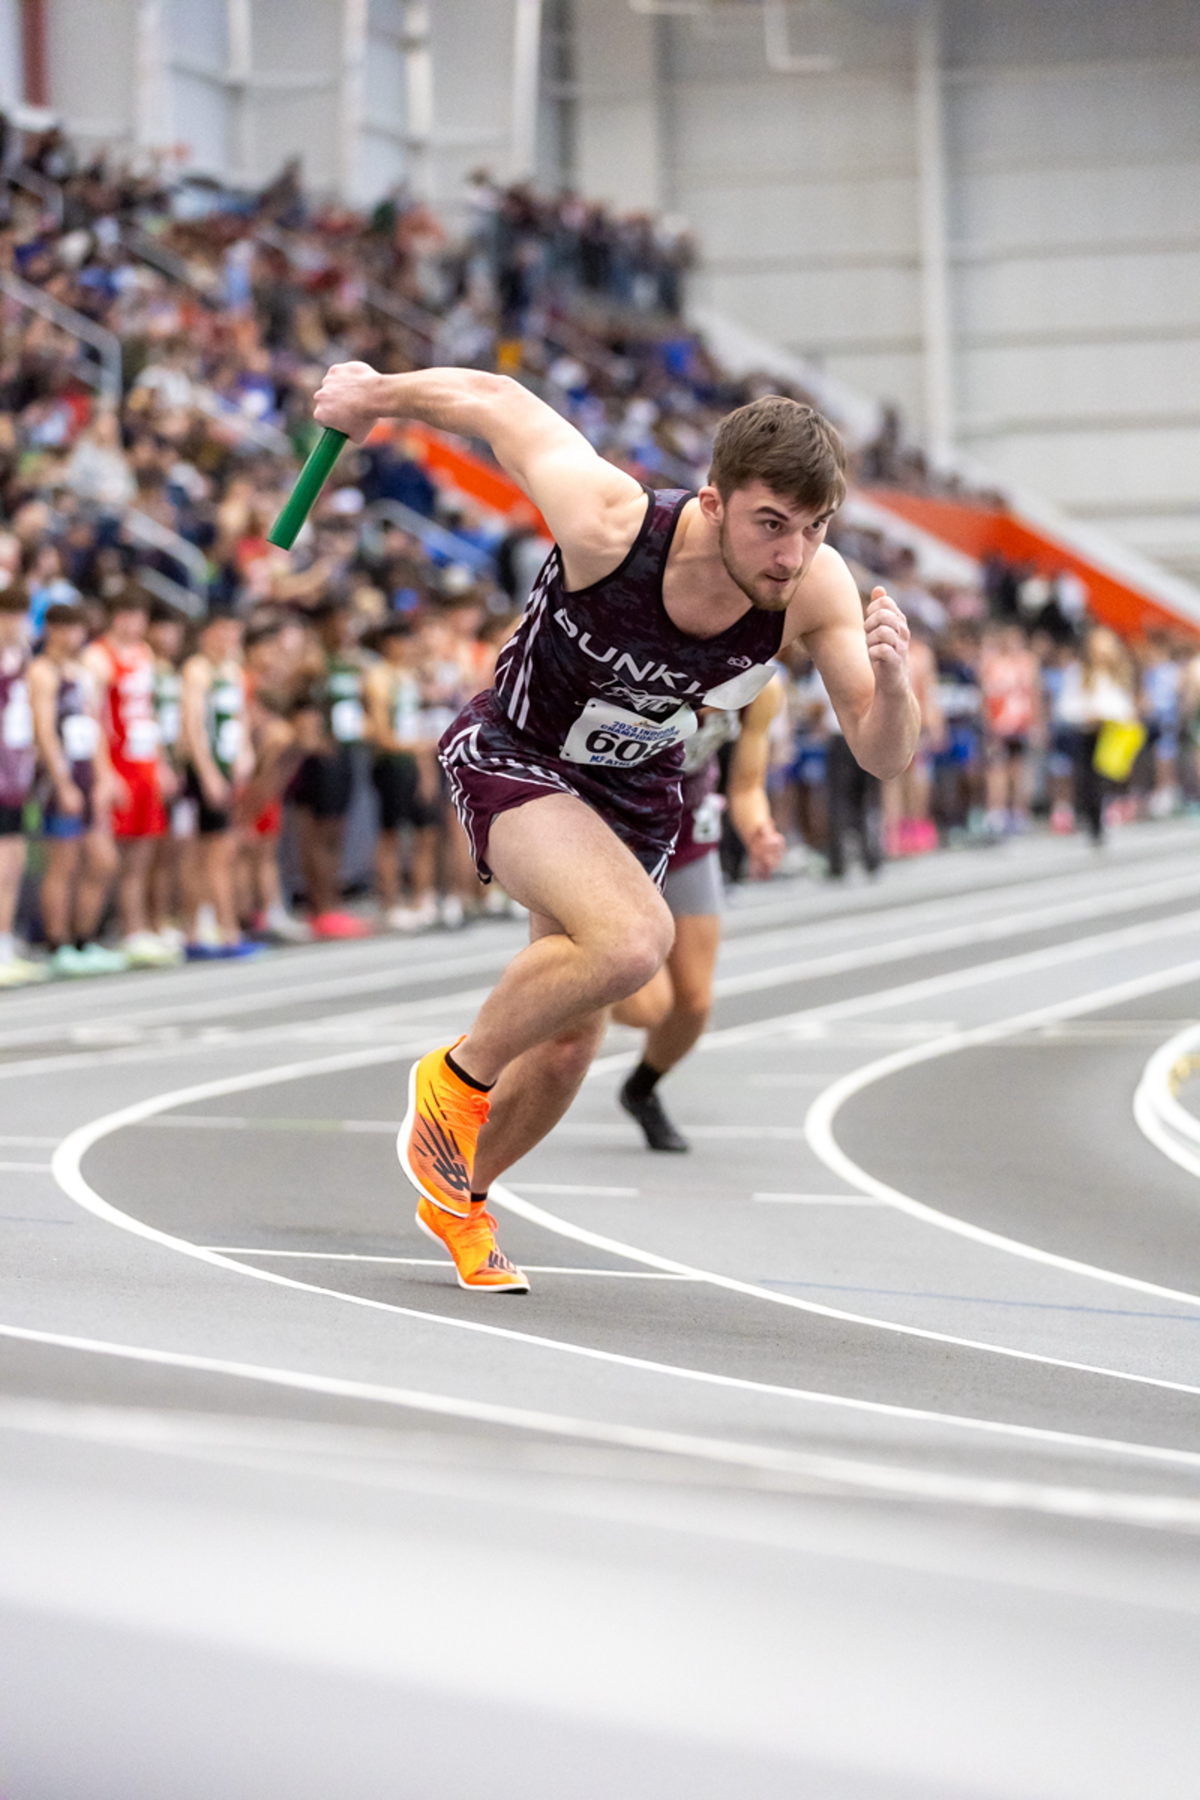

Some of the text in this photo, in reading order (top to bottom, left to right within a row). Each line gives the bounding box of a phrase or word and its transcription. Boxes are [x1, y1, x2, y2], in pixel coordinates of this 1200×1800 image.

[553, 607, 705, 696] DUNKI
[612, 721, 638, 734] 2024
[585, 730, 677, 761] 608
